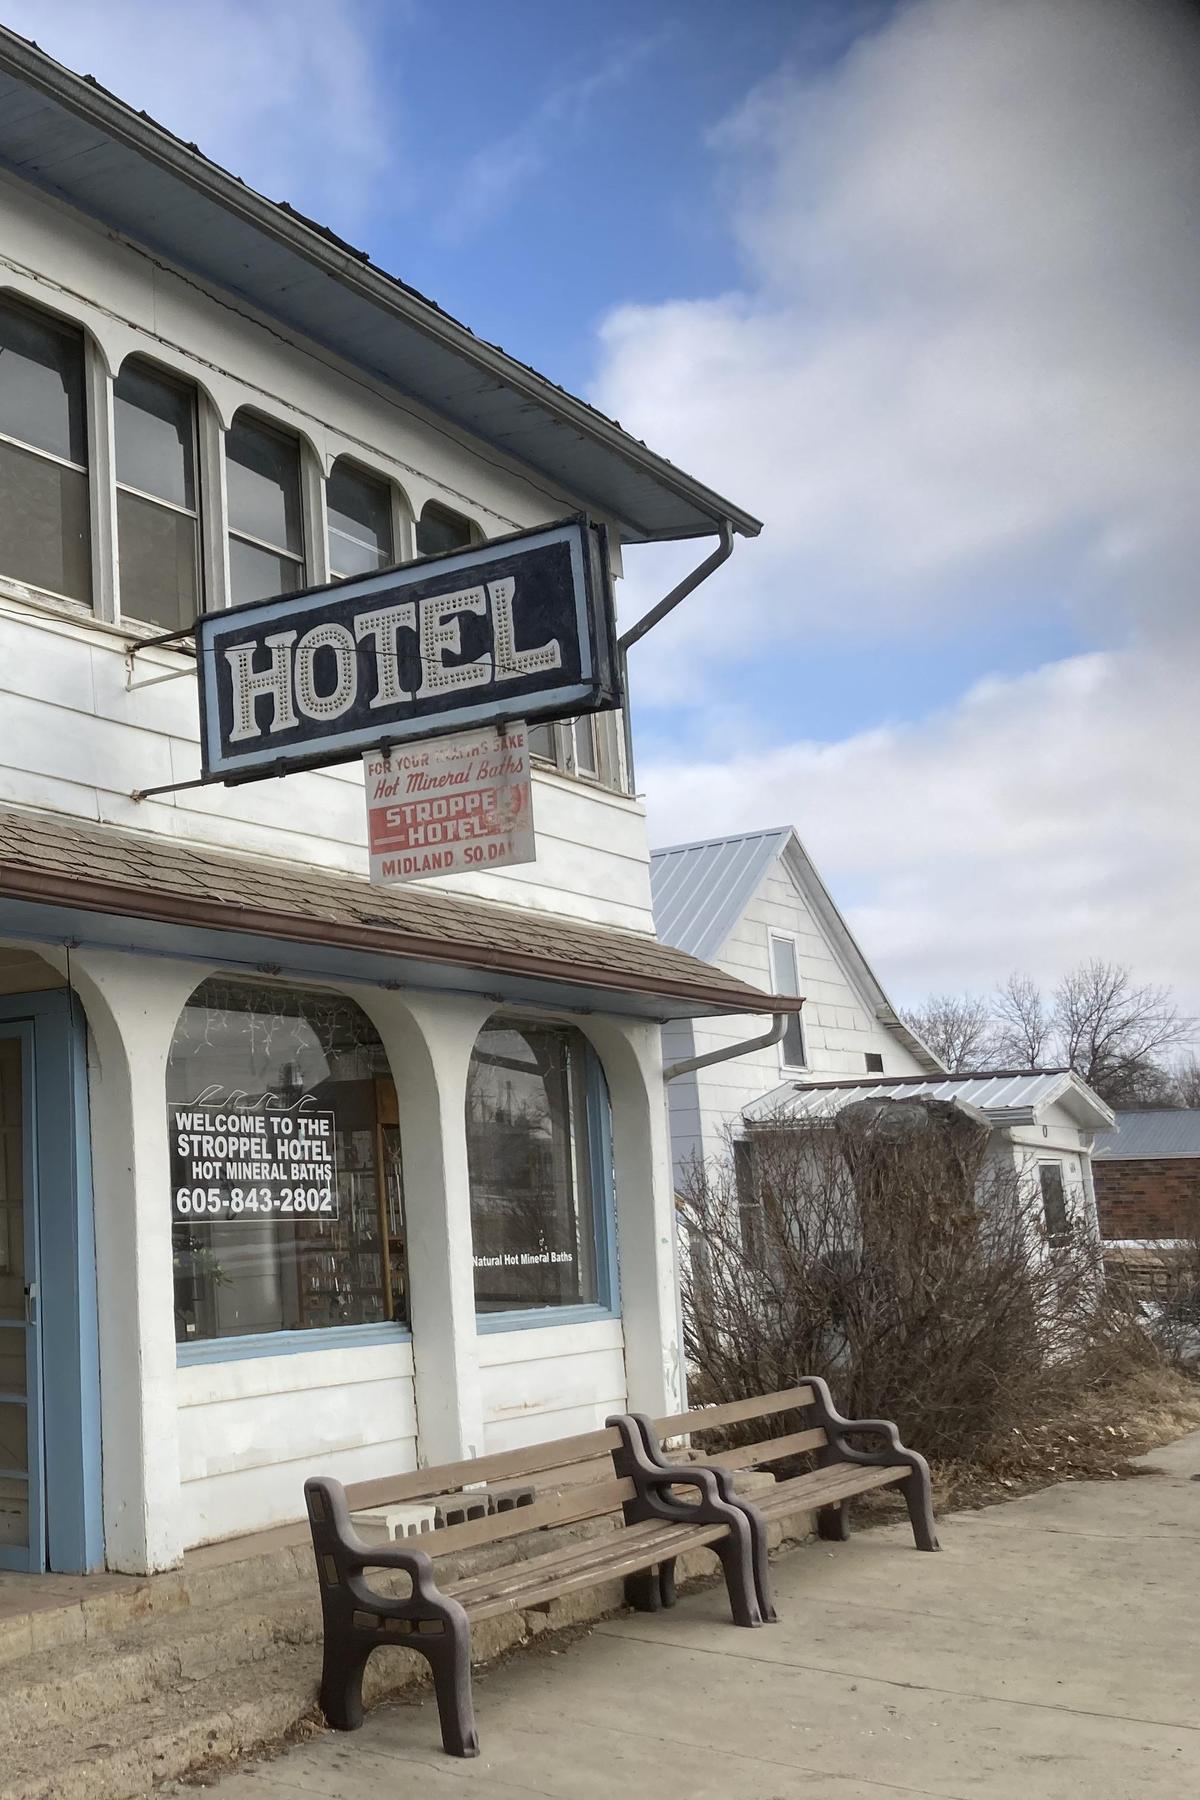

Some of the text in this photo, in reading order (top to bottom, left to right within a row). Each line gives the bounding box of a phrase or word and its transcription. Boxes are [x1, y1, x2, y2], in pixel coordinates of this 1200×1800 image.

[224, 576, 562, 742] HOTEL
[368, 761, 392, 777] FOR
[397, 753, 430, 770] YOUR
[374, 754, 524, 801] Hot Mineral Baths
[408, 815, 488, 846] HOTEL
[382, 851, 454, 877] MIDLAND
[175, 1112, 330, 1136] WELCOME TO THE
[177, 1134, 332, 1161] STROPPEL HOTEL
[192, 1161, 333, 1180] HOT MINERAL BATHS
[176, 1187, 333, 1213] 605-843-2802
[472, 1251, 573, 1267] Natural Hot Mineral Baths
